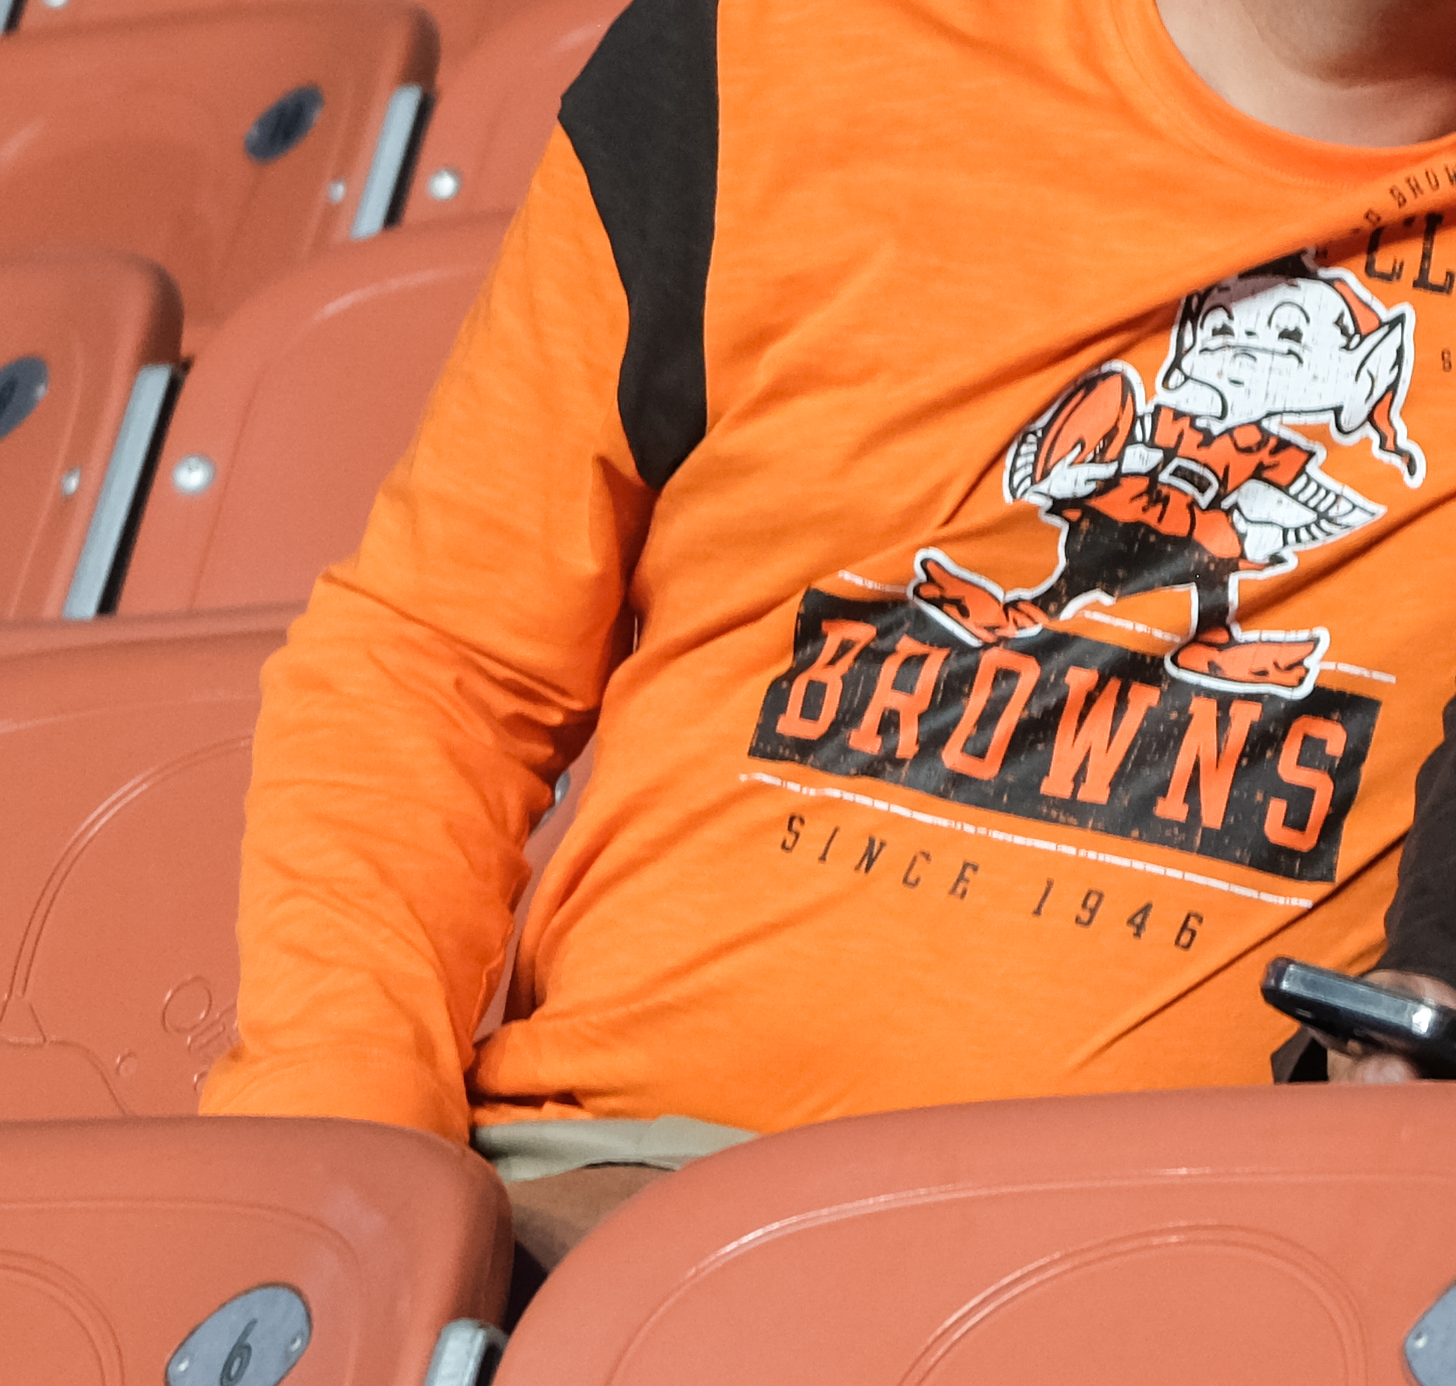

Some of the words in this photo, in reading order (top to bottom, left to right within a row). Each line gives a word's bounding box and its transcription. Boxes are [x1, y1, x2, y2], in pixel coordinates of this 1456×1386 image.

[776, 618, 1348, 853] BROWNS
[780, 814, 980, 900] SINCE
[1031, 878, 1205, 951] 1946
